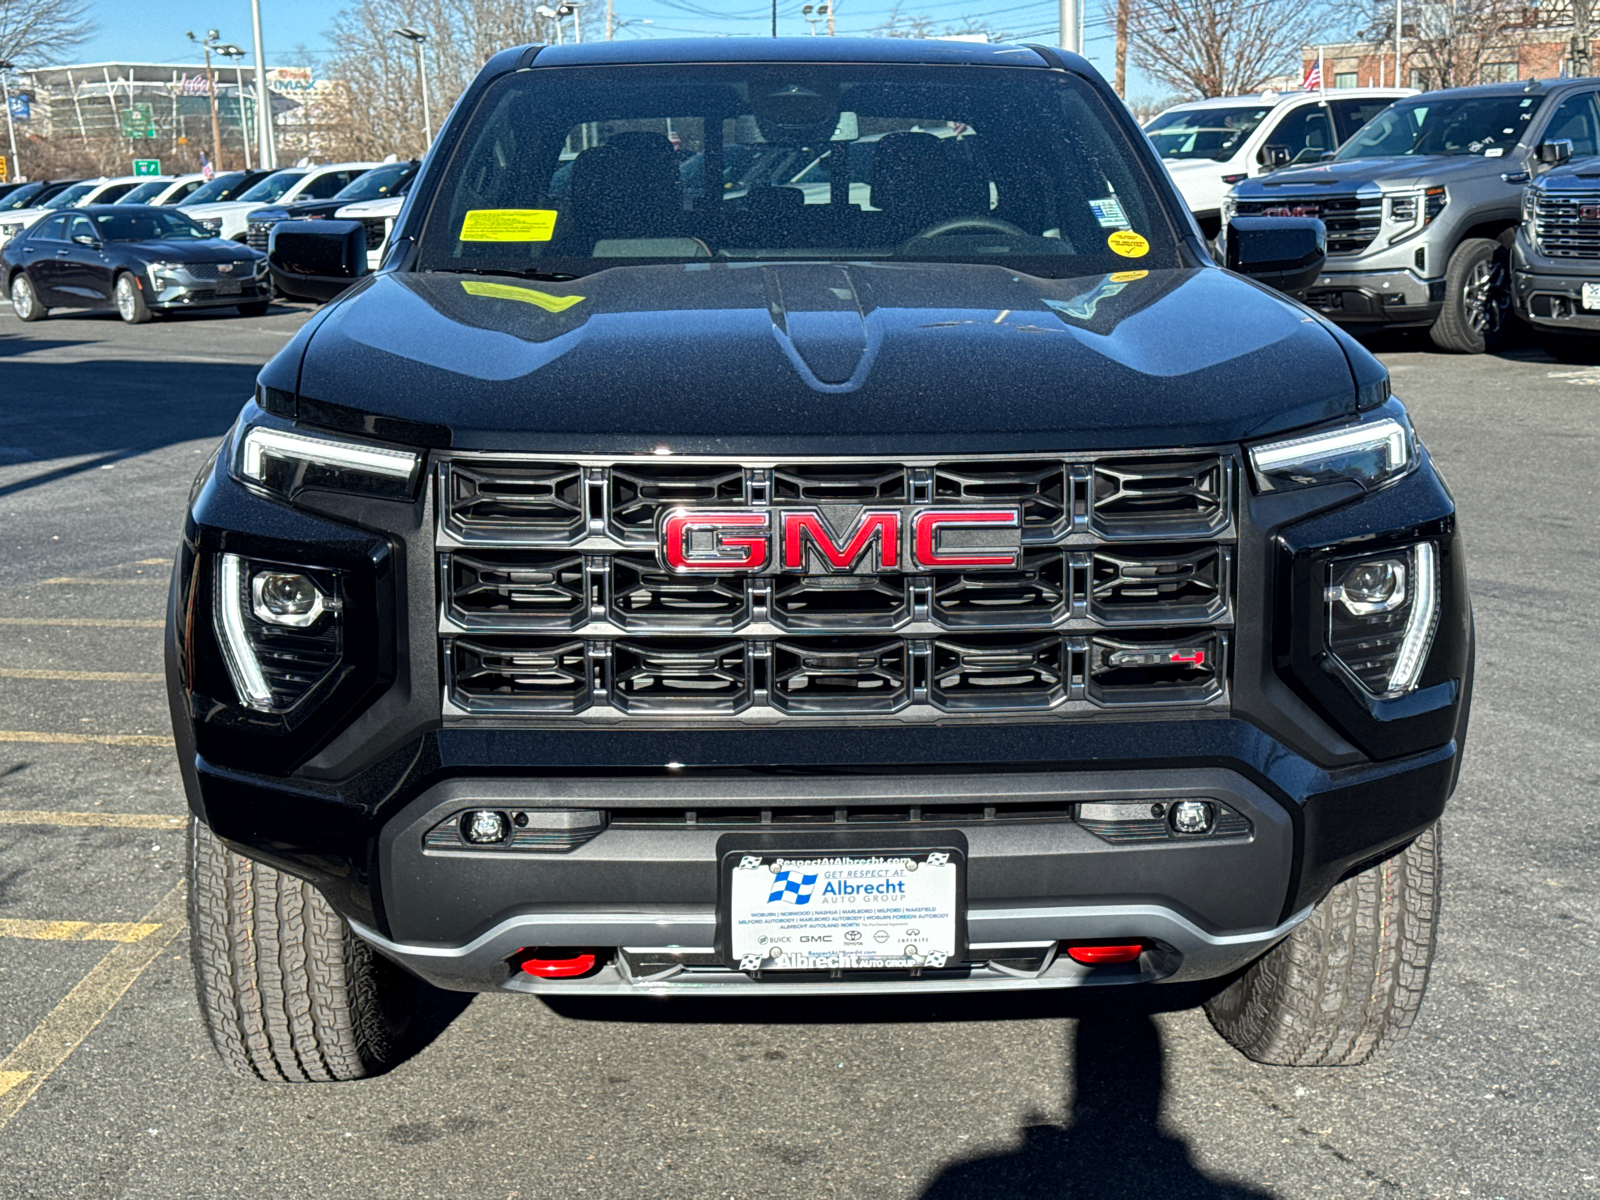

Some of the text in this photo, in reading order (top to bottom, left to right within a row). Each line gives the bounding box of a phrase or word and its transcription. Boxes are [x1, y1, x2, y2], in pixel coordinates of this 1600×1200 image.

[274, 80, 317, 91] IMAX
[663, 507, 1021, 573] GMC
[776, 857, 912, 867] RespectAtAlbrecht.com
[822, 879, 906, 895] Albrecht
[822, 894, 906, 904] AUTO GROUP
[774, 952, 916, 968] Albrecht AUTO GROUP
